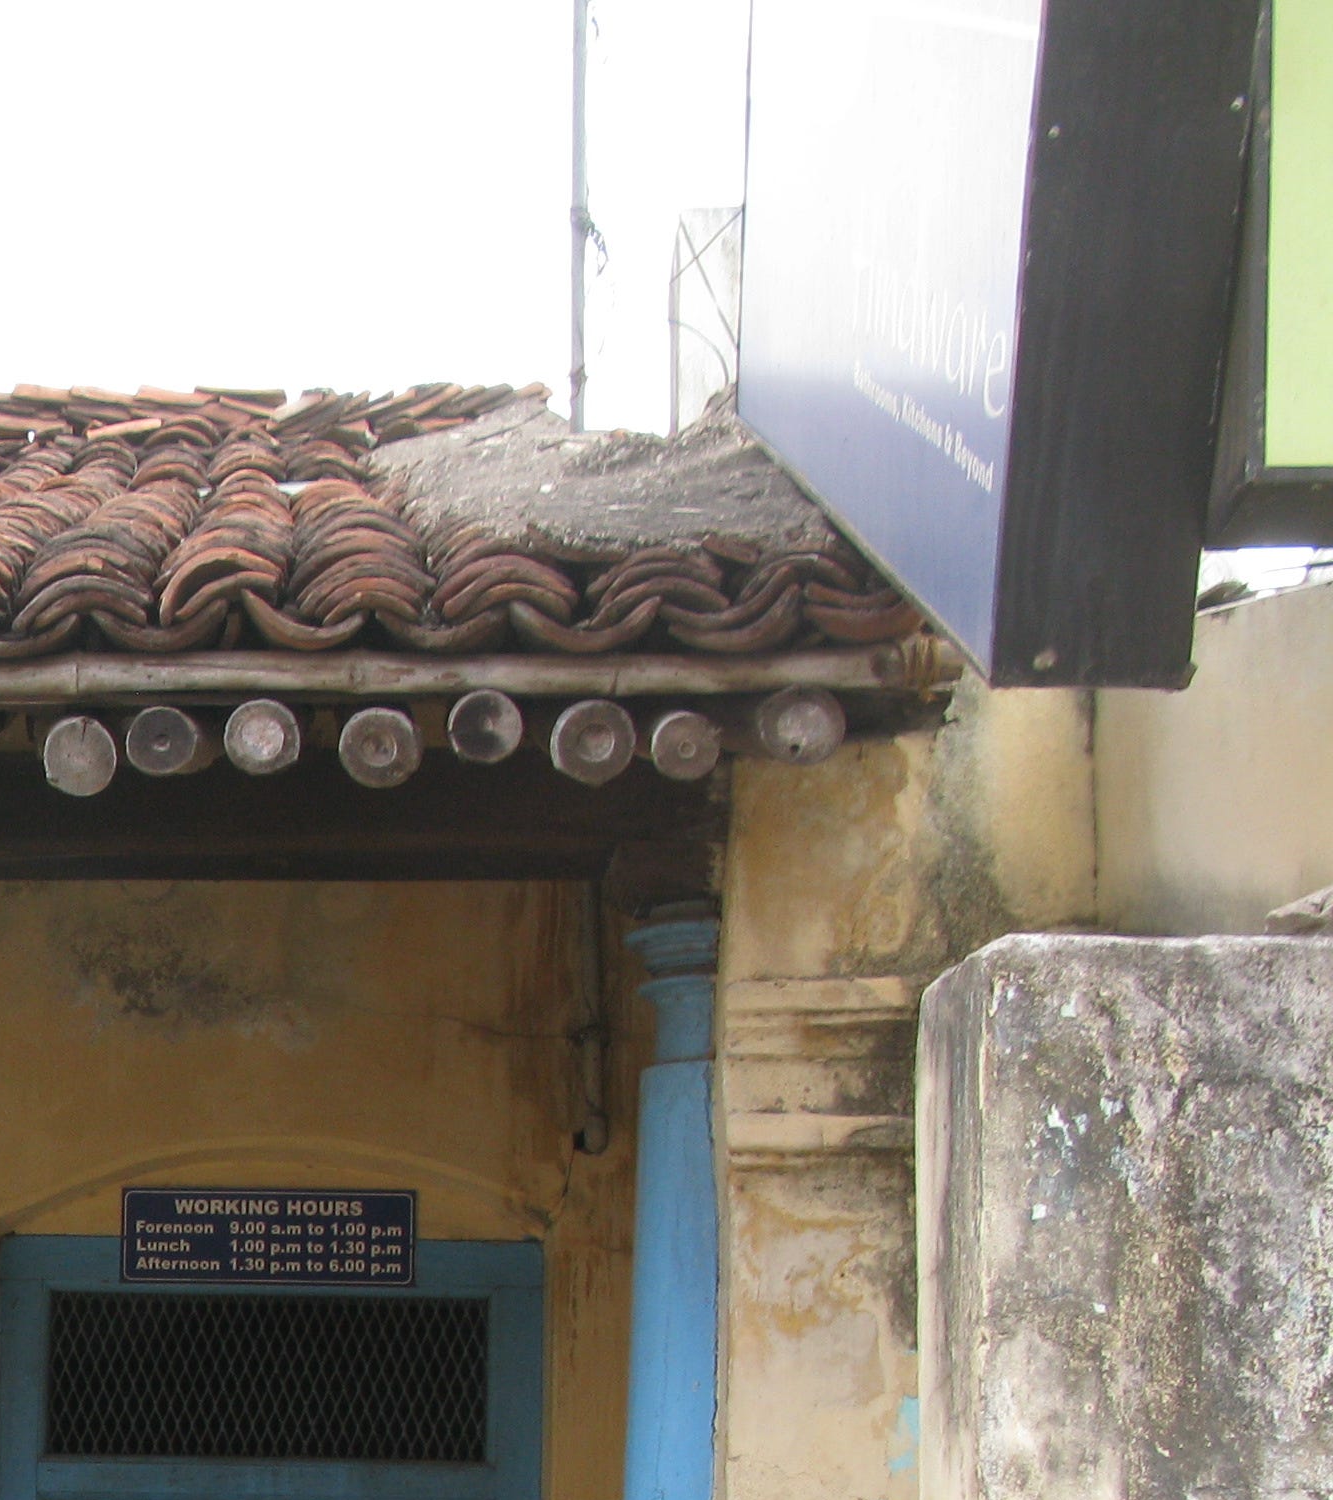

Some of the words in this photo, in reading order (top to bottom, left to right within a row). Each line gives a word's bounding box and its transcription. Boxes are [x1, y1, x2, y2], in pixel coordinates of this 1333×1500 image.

[954, 430, 994, 493] Beyond
[175, 1199, 280, 1216] WORKING
[287, 1201, 363, 1217] HOURS
[136, 1220, 214, 1235] Forenoon
[230, 1222, 265, 1235] 9.00
[271, 1225, 301, 1235] a.m
[307, 1224, 324, 1236] to
[330, 1223, 366, 1237] 1.00
[371, 1226, 402, 1239] p.m
[136, 1239, 190, 1252] Lunch
[230, 1240, 265, 1253] 1.00
[270, 1243, 301, 1256] p.m
[307, 1242, 323, 1254] to
[330, 1242, 365, 1255] 1.30
[371, 1245, 401, 1258] p.m
[136, 1257, 220, 1271] Afternoon
[230, 1258, 265, 1272] 1.30
[270, 1262, 300, 1275] p.m
[307, 1261, 323, 1273] to
[329, 1260, 365, 1273] 6.00
[370, 1263, 401, 1276] p.m
